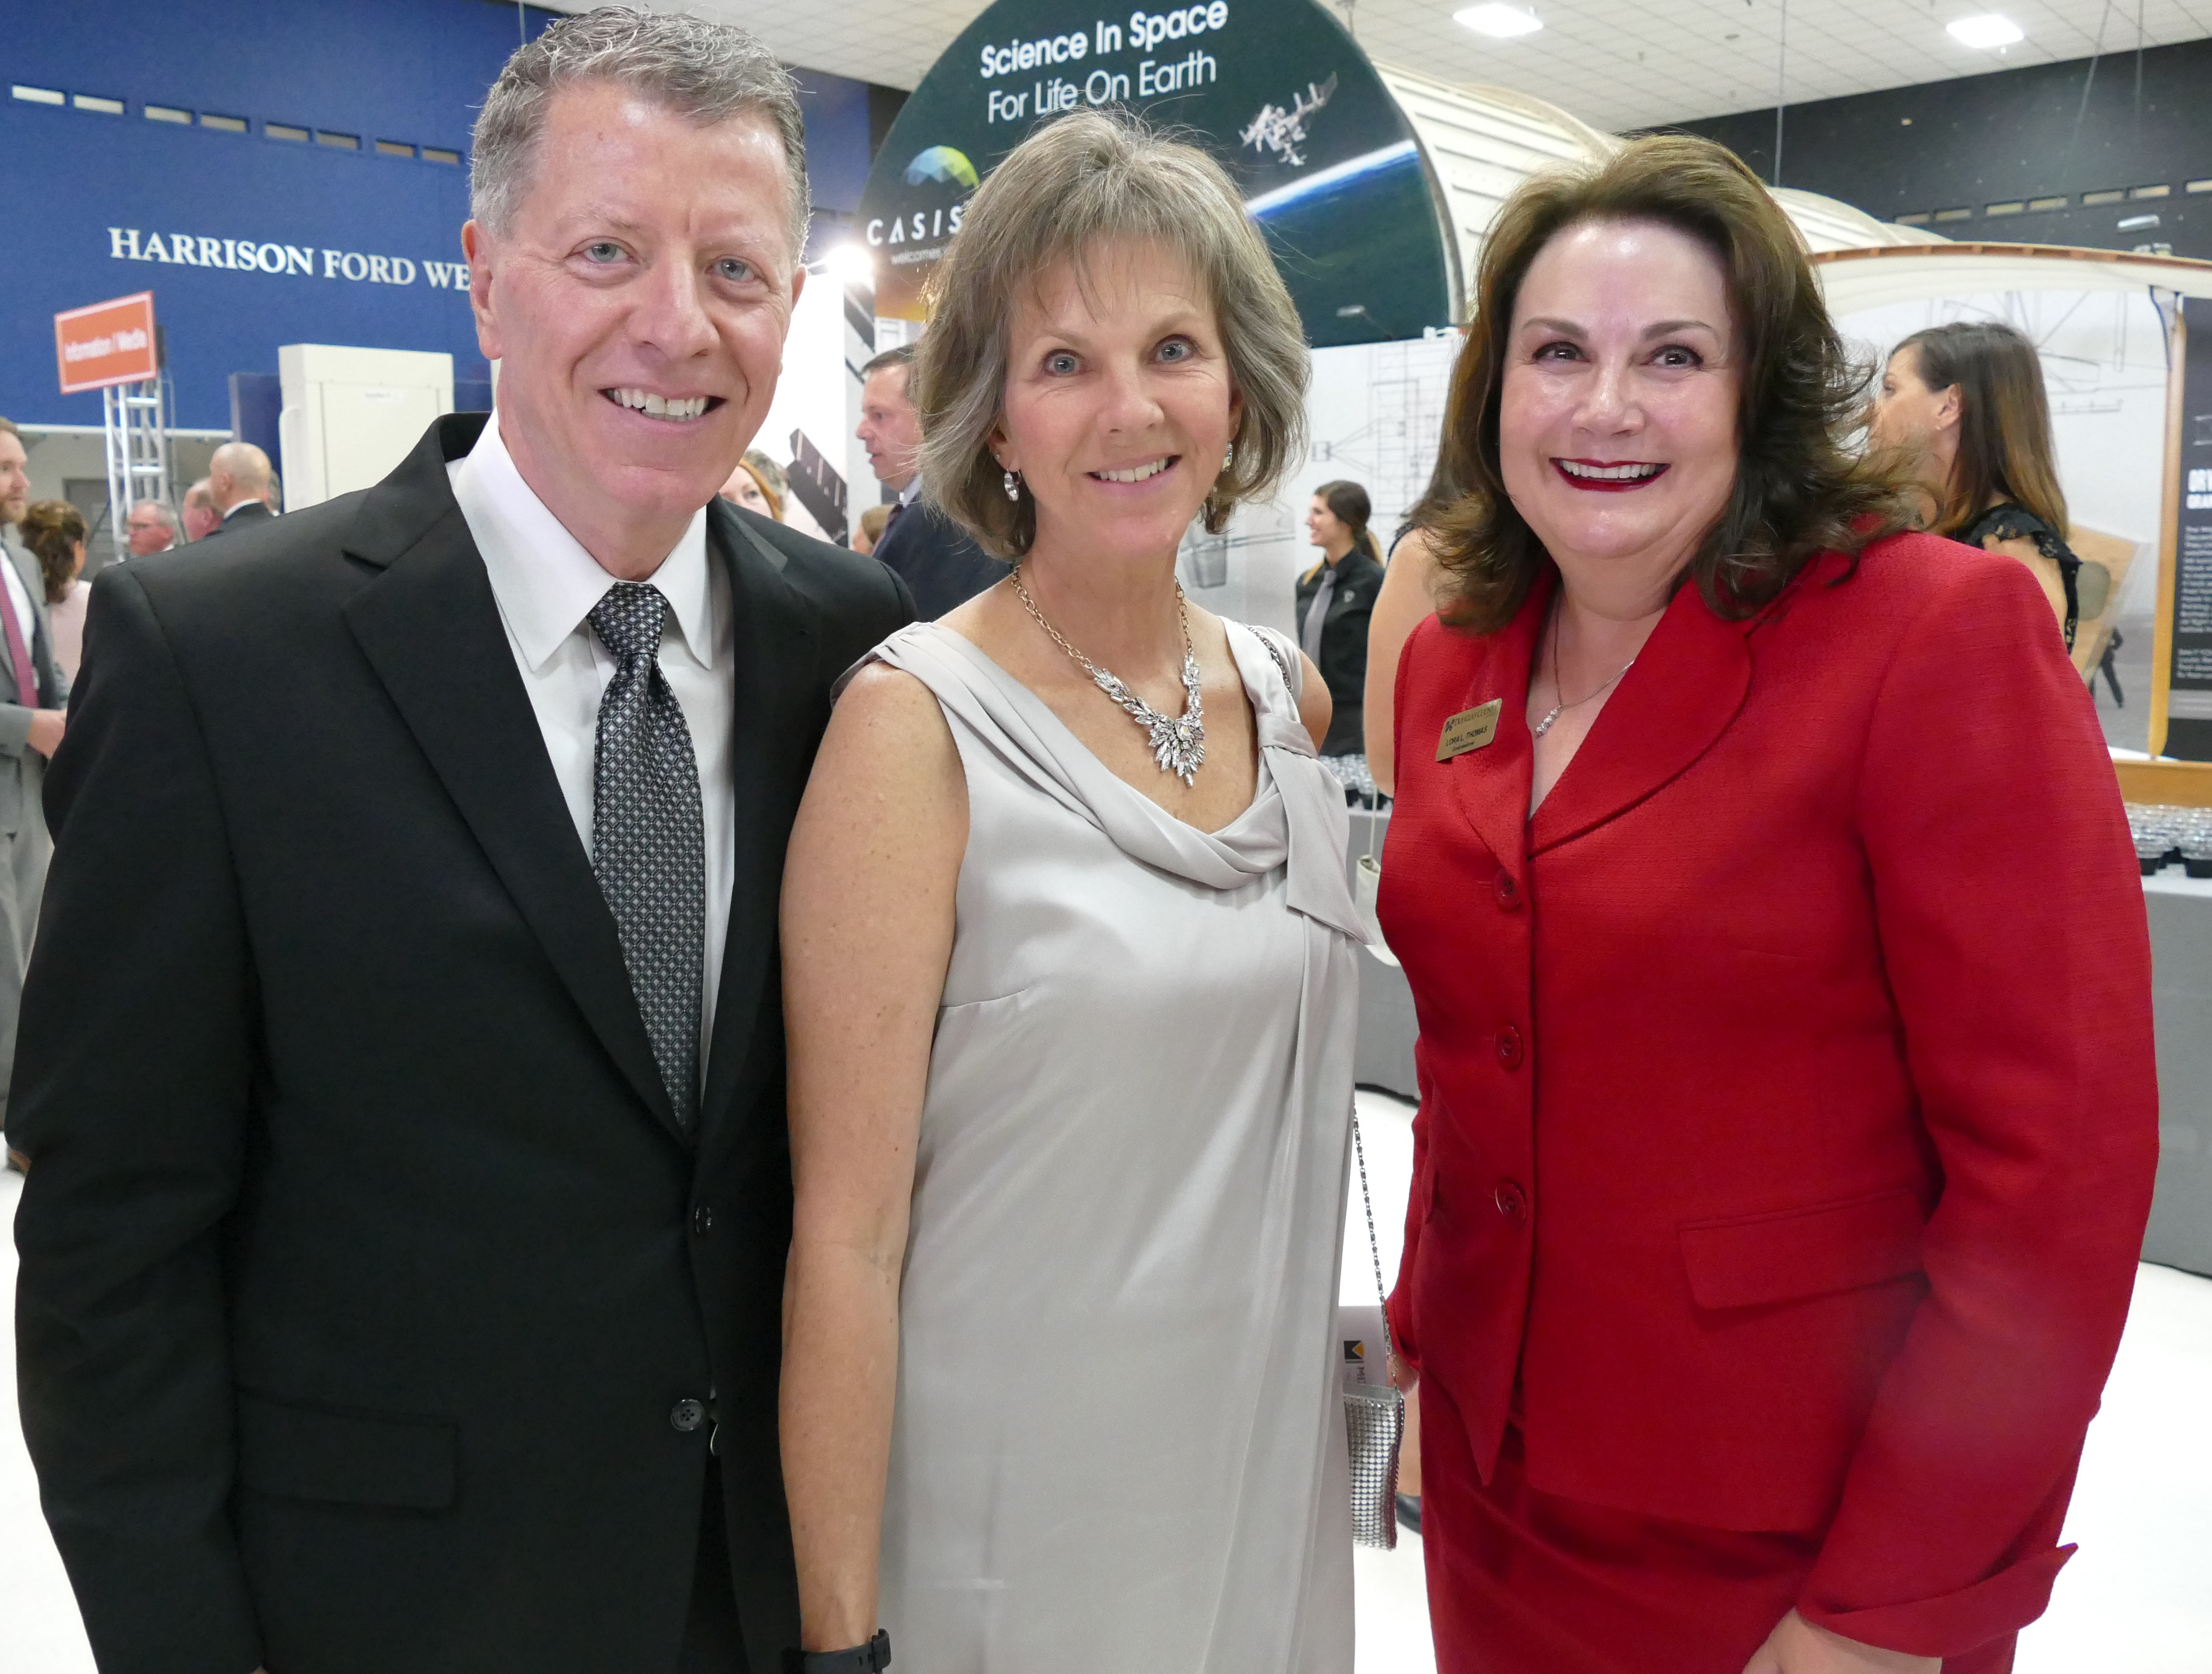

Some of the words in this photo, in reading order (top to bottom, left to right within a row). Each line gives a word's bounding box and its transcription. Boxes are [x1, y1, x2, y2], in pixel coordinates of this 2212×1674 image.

[980, 32, 1089, 79] Science
[1095, 20, 1122, 55] In
[1129, 0, 1229, 52] Space
[988, 89, 1029, 124] For
[1035, 77, 1079, 115] Life
[1085, 70, 1130, 105] On
[1139, 49, 1216, 96] Earth
[107, 227, 314, 277] HARRISON
[321, 249, 417, 286] FORD
[866, 204, 963, 246] CASIS
